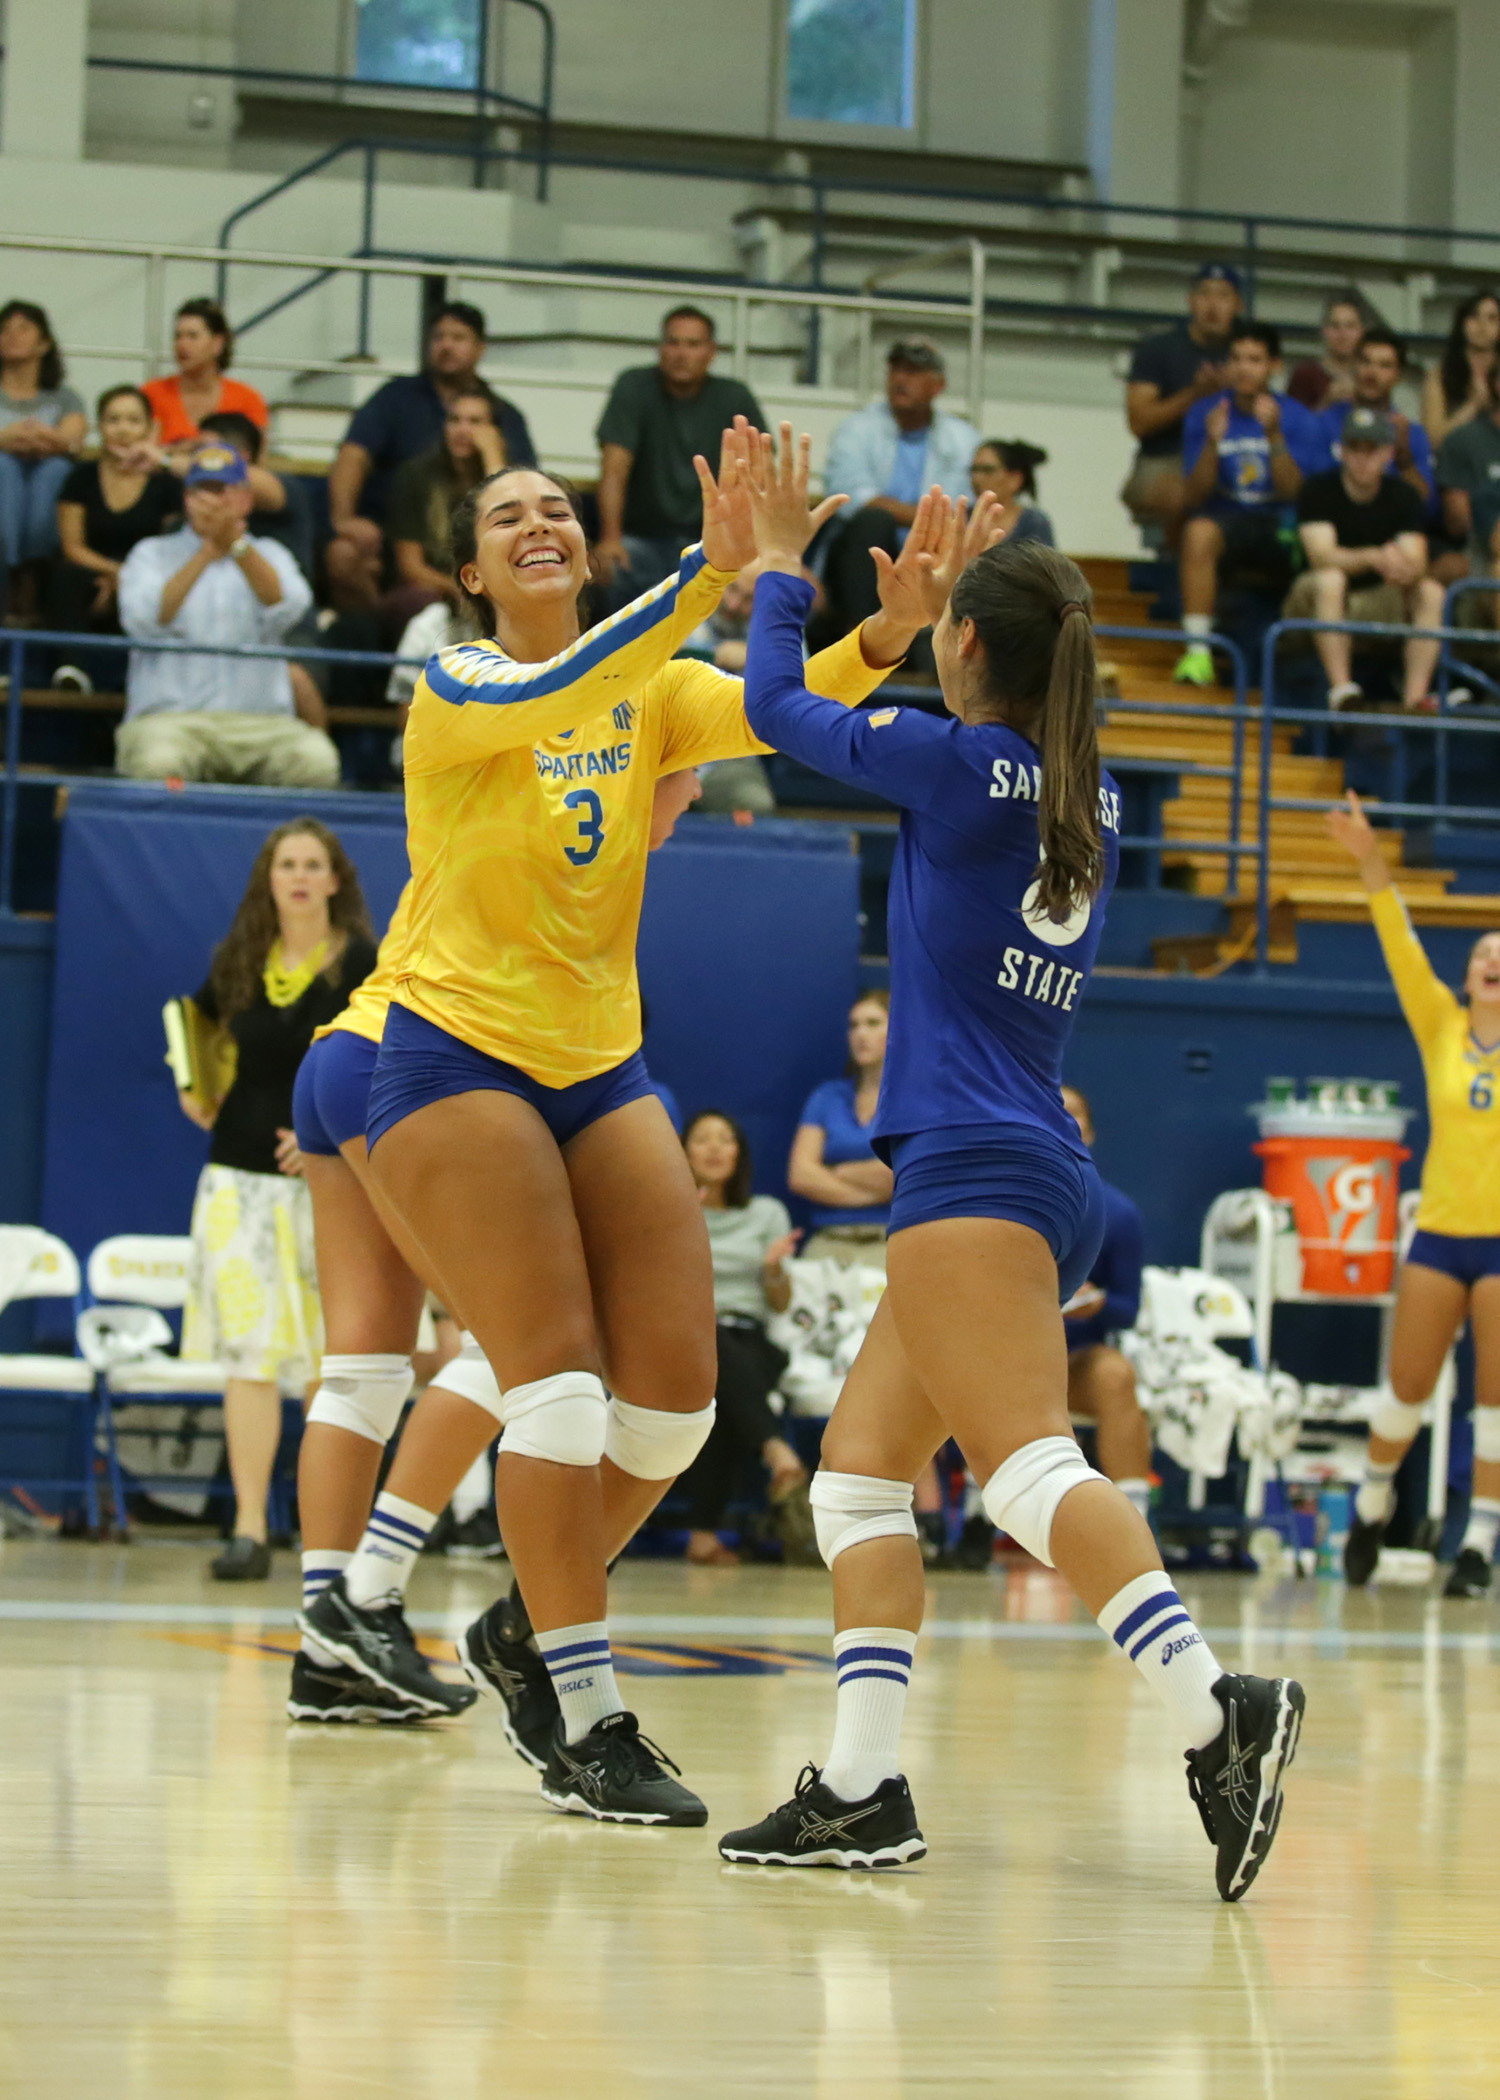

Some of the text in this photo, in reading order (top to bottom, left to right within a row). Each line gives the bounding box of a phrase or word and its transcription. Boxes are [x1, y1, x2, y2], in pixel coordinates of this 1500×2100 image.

[534, 742, 631, 780] SPARTANS
[563, 788, 605, 866] 3
[997, 946, 1084, 1012] STATE
[1469, 1072, 1494, 1111] 6
[1334, 1163, 1375, 1212] G
